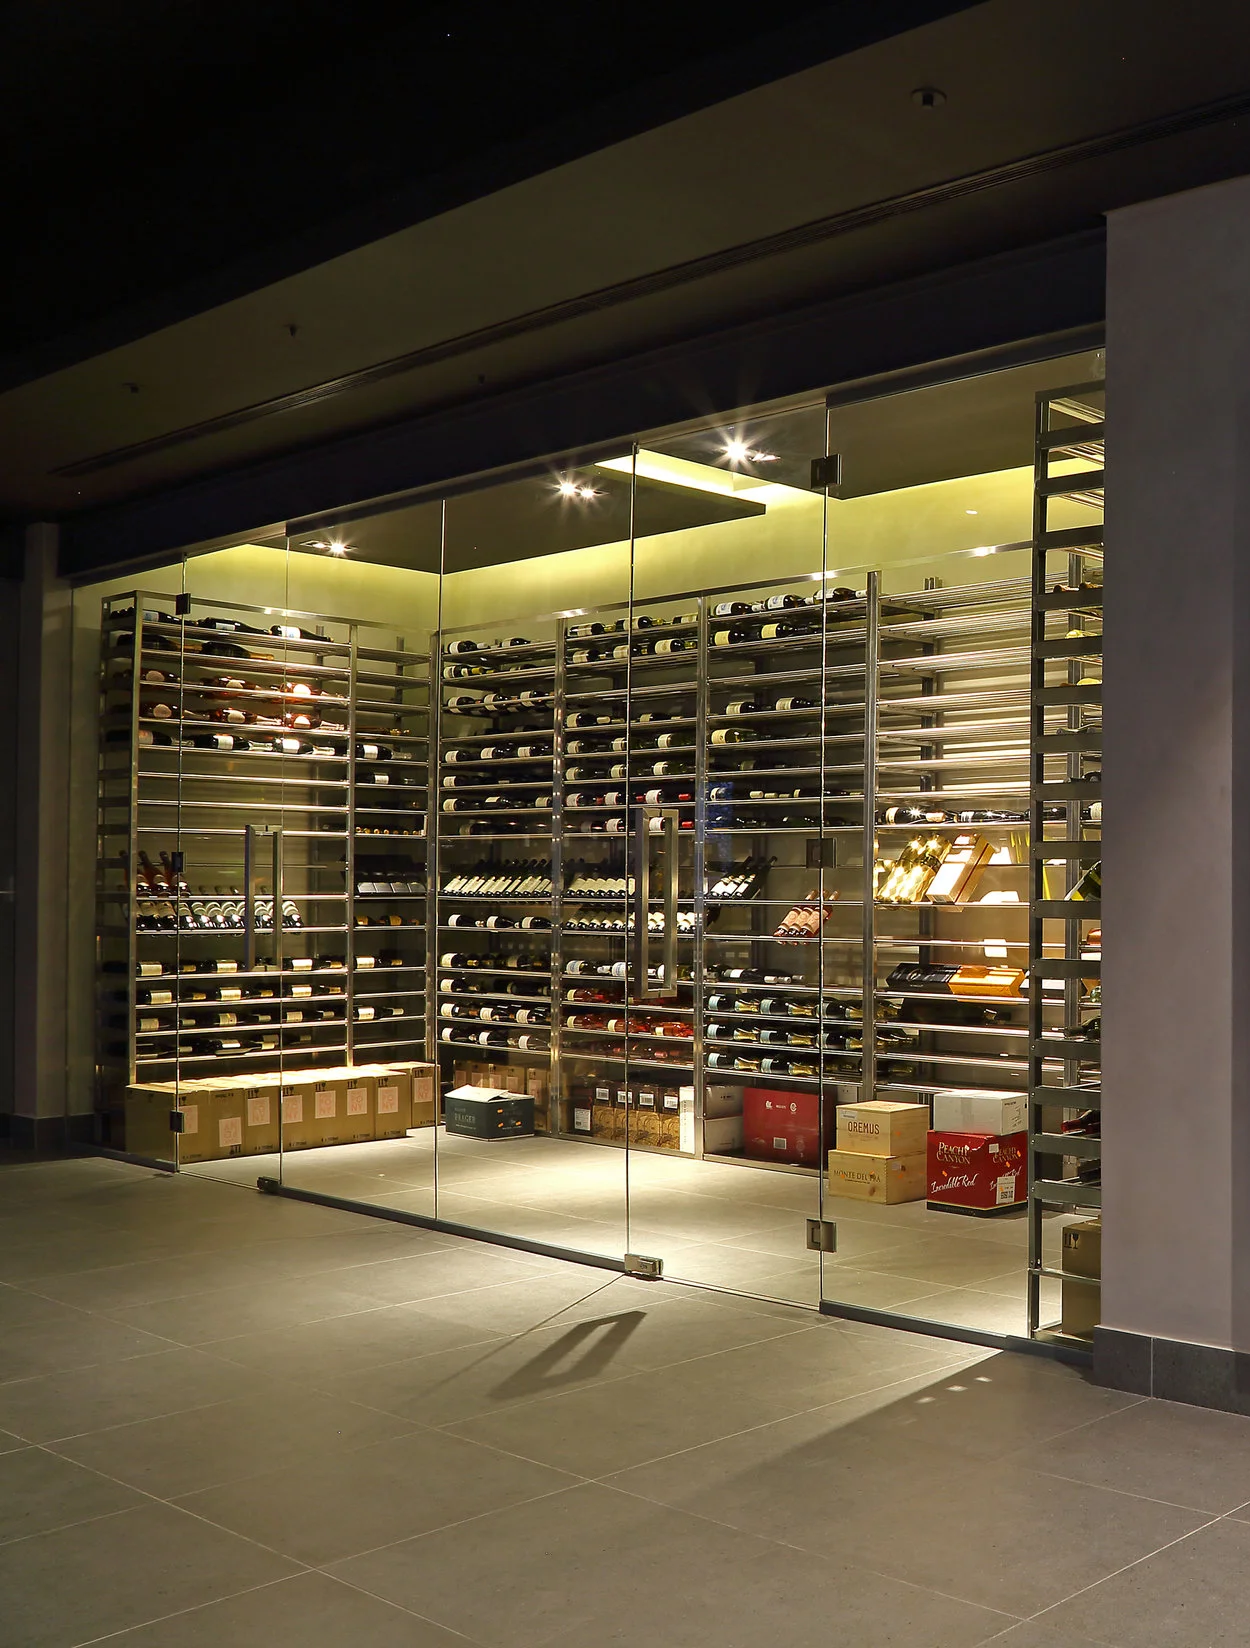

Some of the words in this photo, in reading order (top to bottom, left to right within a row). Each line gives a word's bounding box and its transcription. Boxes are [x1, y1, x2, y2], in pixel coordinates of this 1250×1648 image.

[847, 1121, 880, 1135] OREMUS
[936, 1150, 971, 1165] CANYON
[958, 1173, 979, 1188] Red
